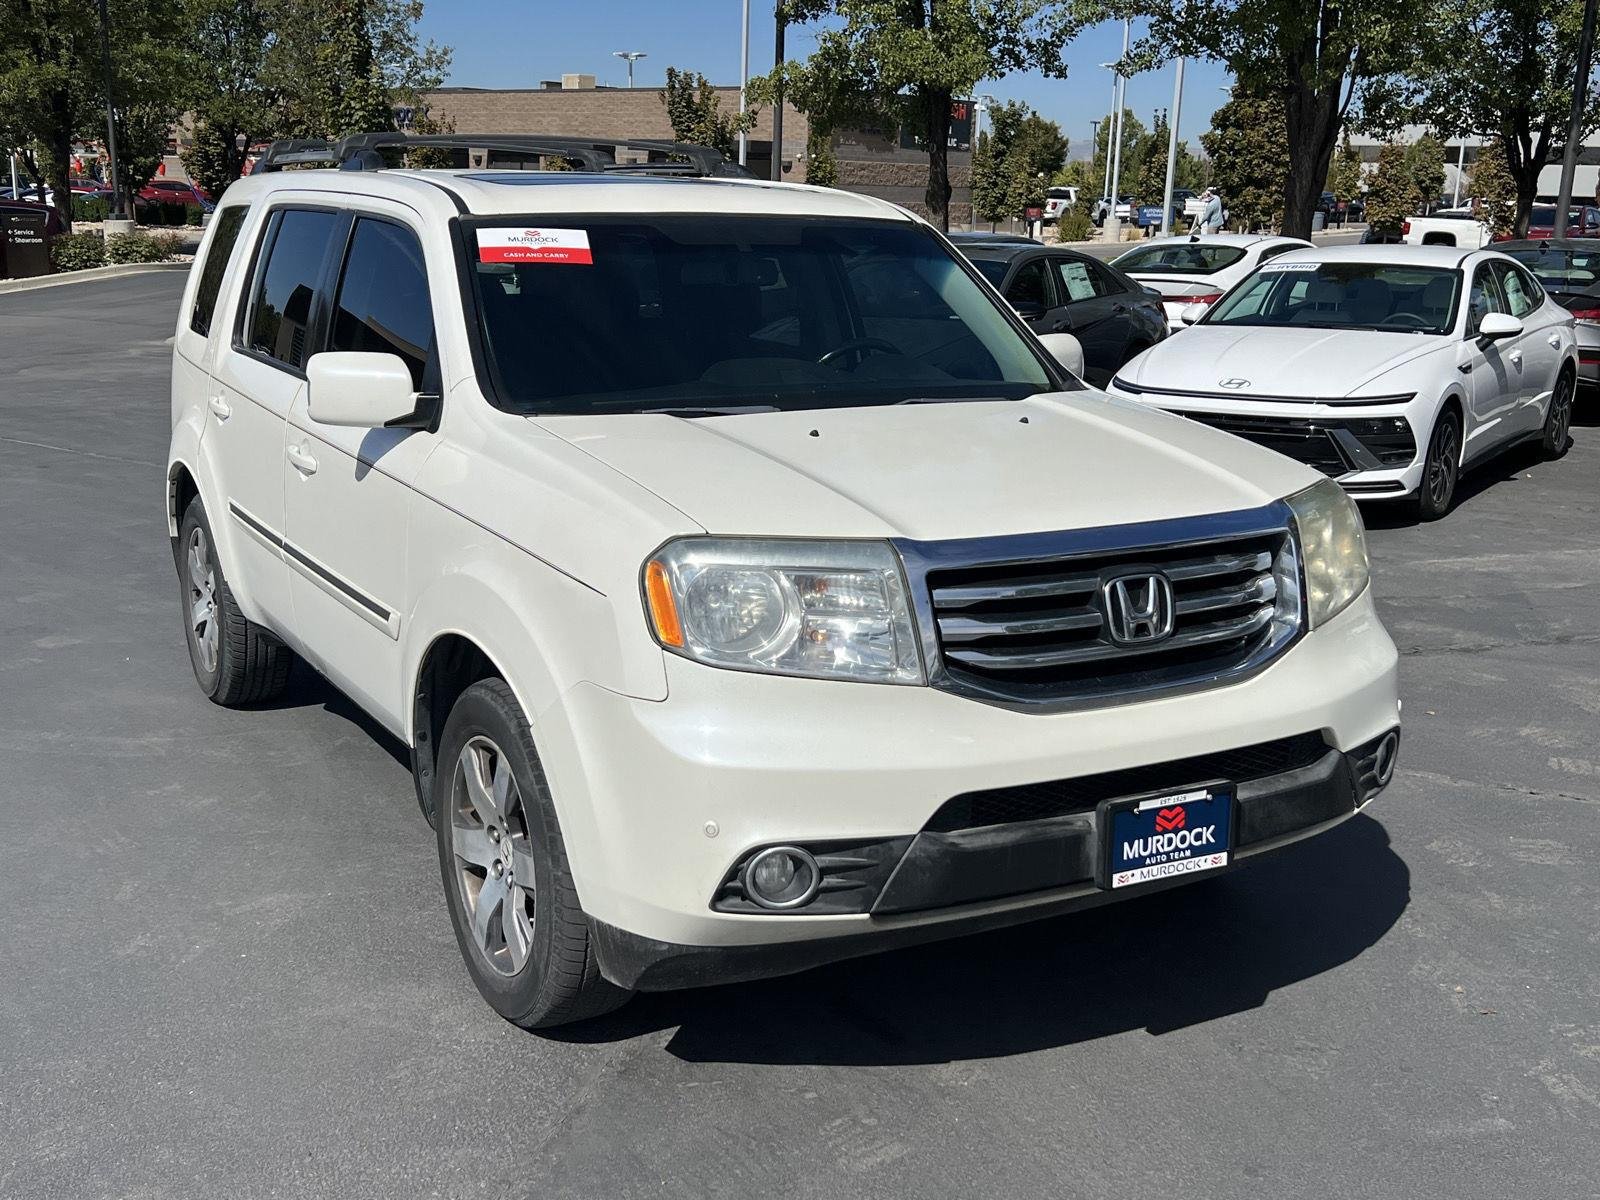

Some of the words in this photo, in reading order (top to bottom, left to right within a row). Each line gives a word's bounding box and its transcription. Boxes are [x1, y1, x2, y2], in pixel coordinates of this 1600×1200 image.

[1123, 825, 1216, 860] MURDOCK
[1145, 854, 1167, 866] AUTO
[1169, 849, 1191, 860] TEAM
[1139, 858, 1201, 880] MURDOCK
